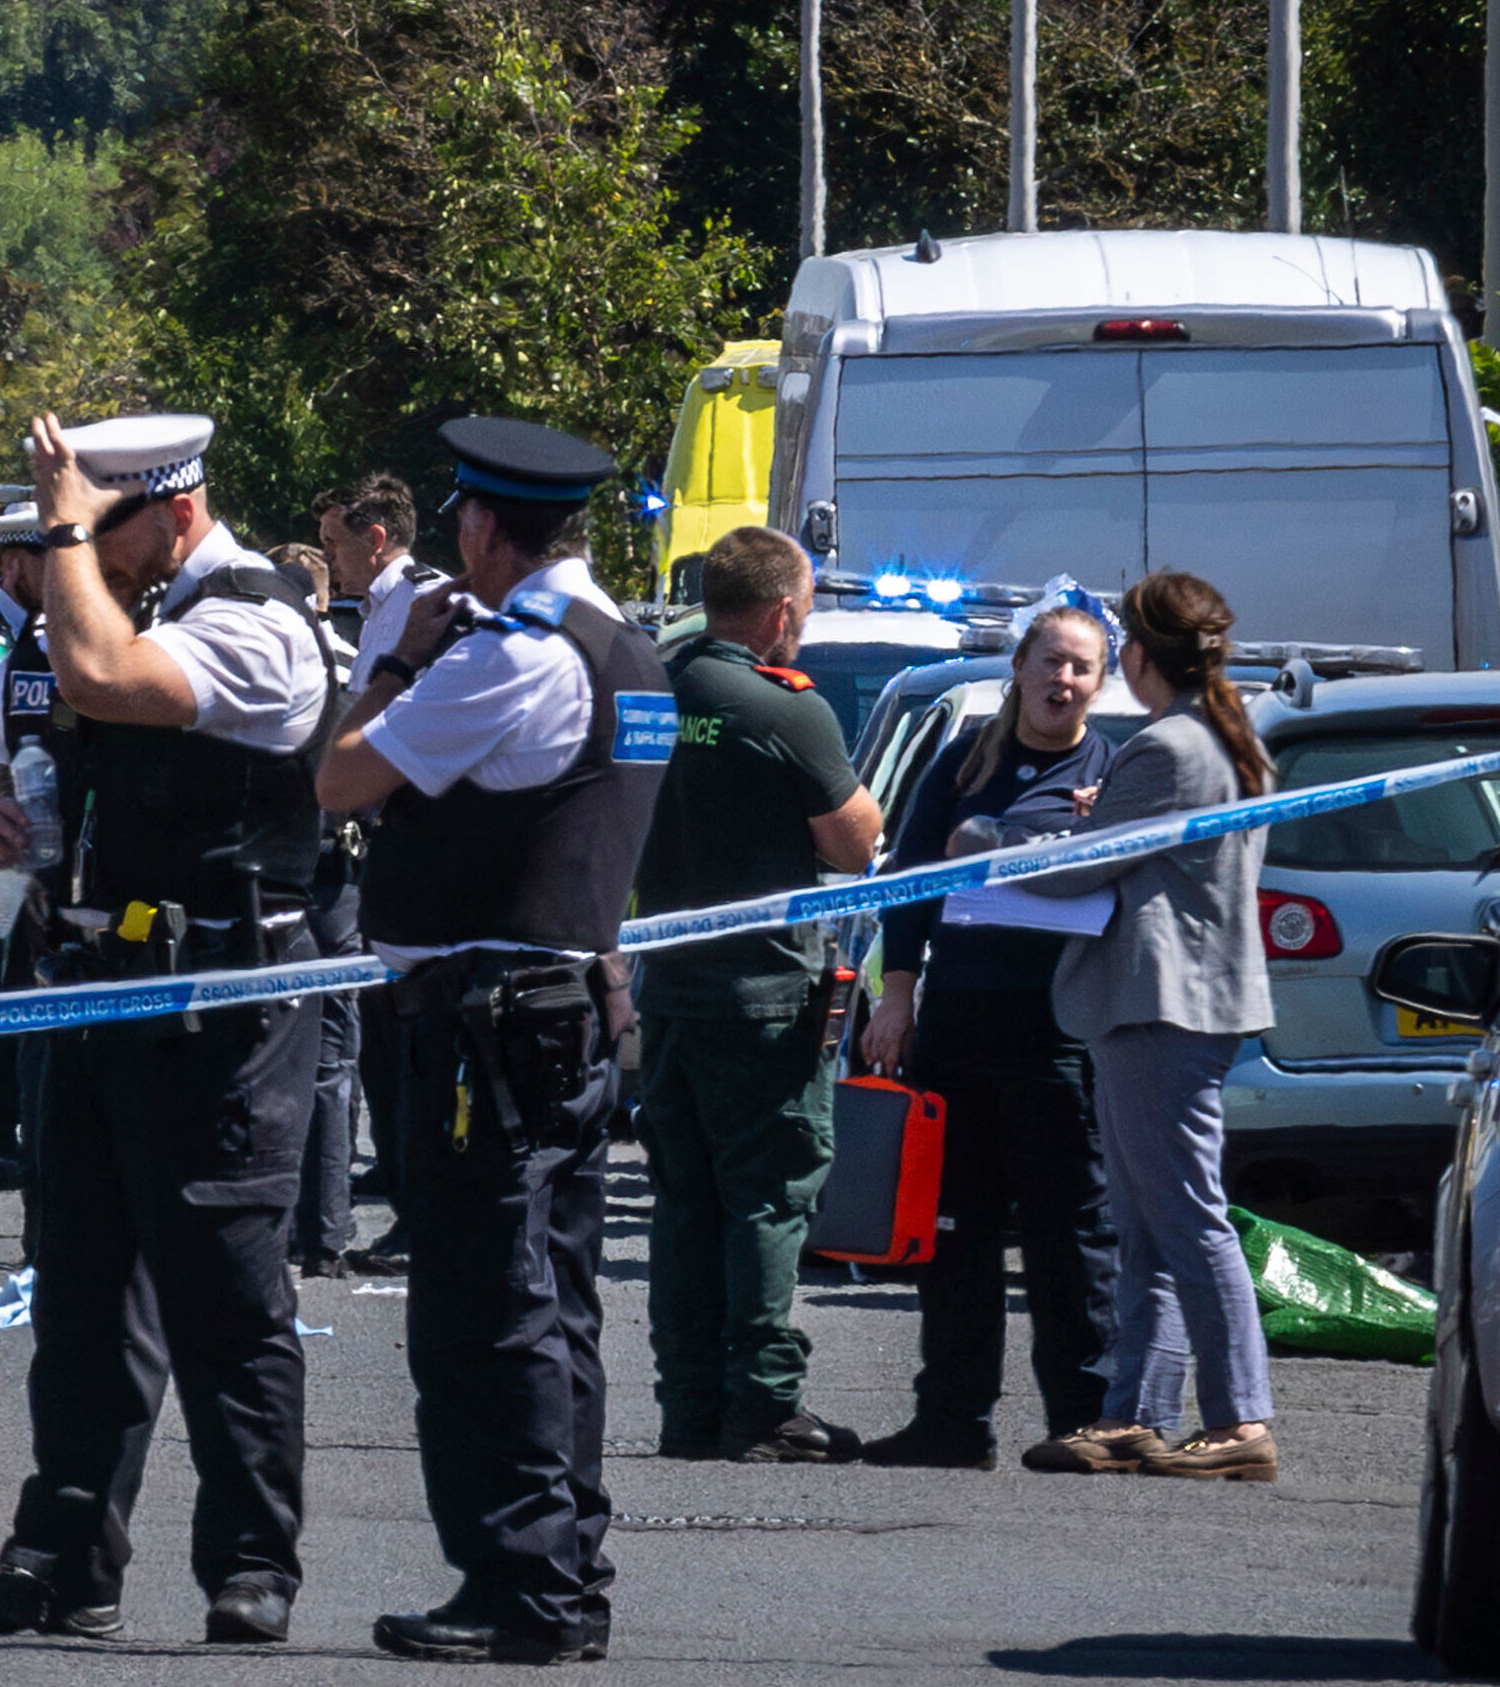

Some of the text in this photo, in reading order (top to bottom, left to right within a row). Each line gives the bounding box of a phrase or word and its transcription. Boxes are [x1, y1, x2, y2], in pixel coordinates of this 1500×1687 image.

[0, 1003, 55, 1025] POLICE
[84, 998, 117, 1017] NOT
[120, 992, 173, 1014] CROSS
